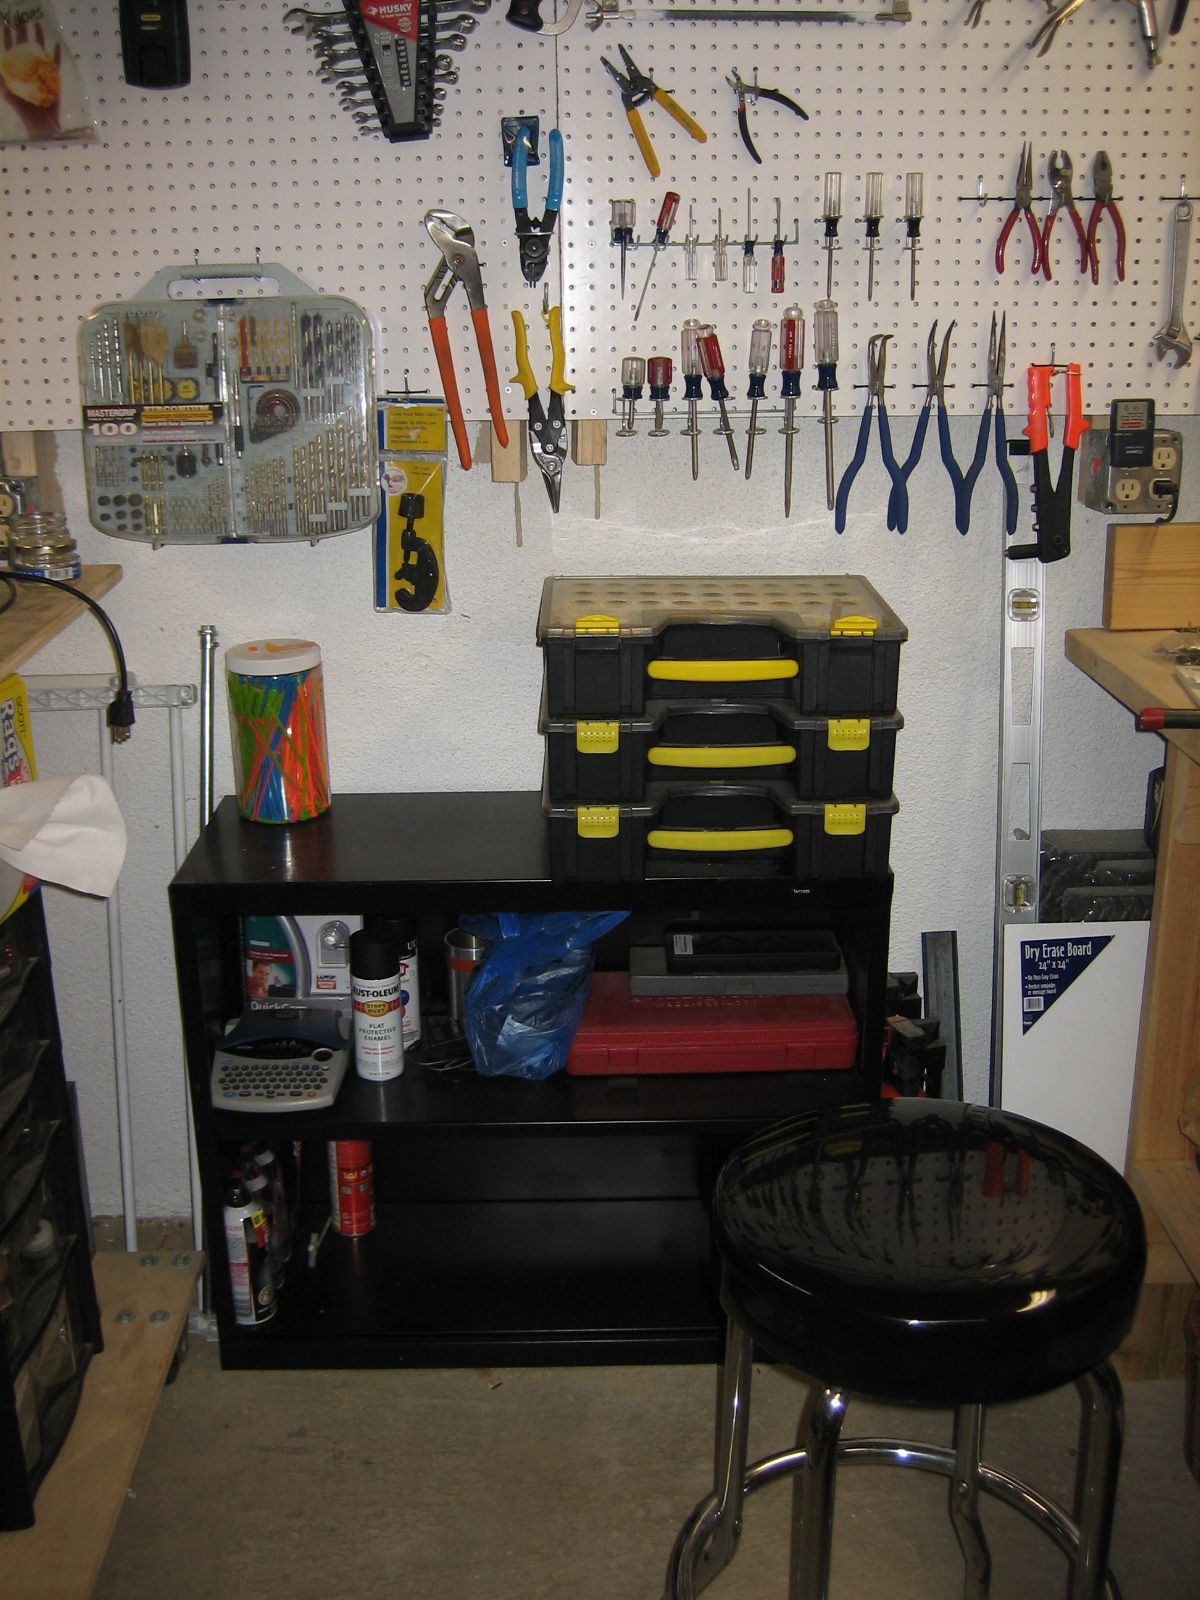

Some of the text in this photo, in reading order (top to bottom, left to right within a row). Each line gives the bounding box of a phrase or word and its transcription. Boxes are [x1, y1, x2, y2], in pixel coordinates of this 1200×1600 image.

[380, 4, 412, 14] HUSKY
[87, 408, 137, 417] MASTERGRIP
[88, 422, 138, 436] 100
[1, 697, 18, 773] Rags
[1025, 941, 1092, 962] Dry Erase Board
[1039, 960, 1051, 971] 24"
[1057, 958, 1070, 970] 24"
[359, 1026, 396, 1035] PROTECTIVE
